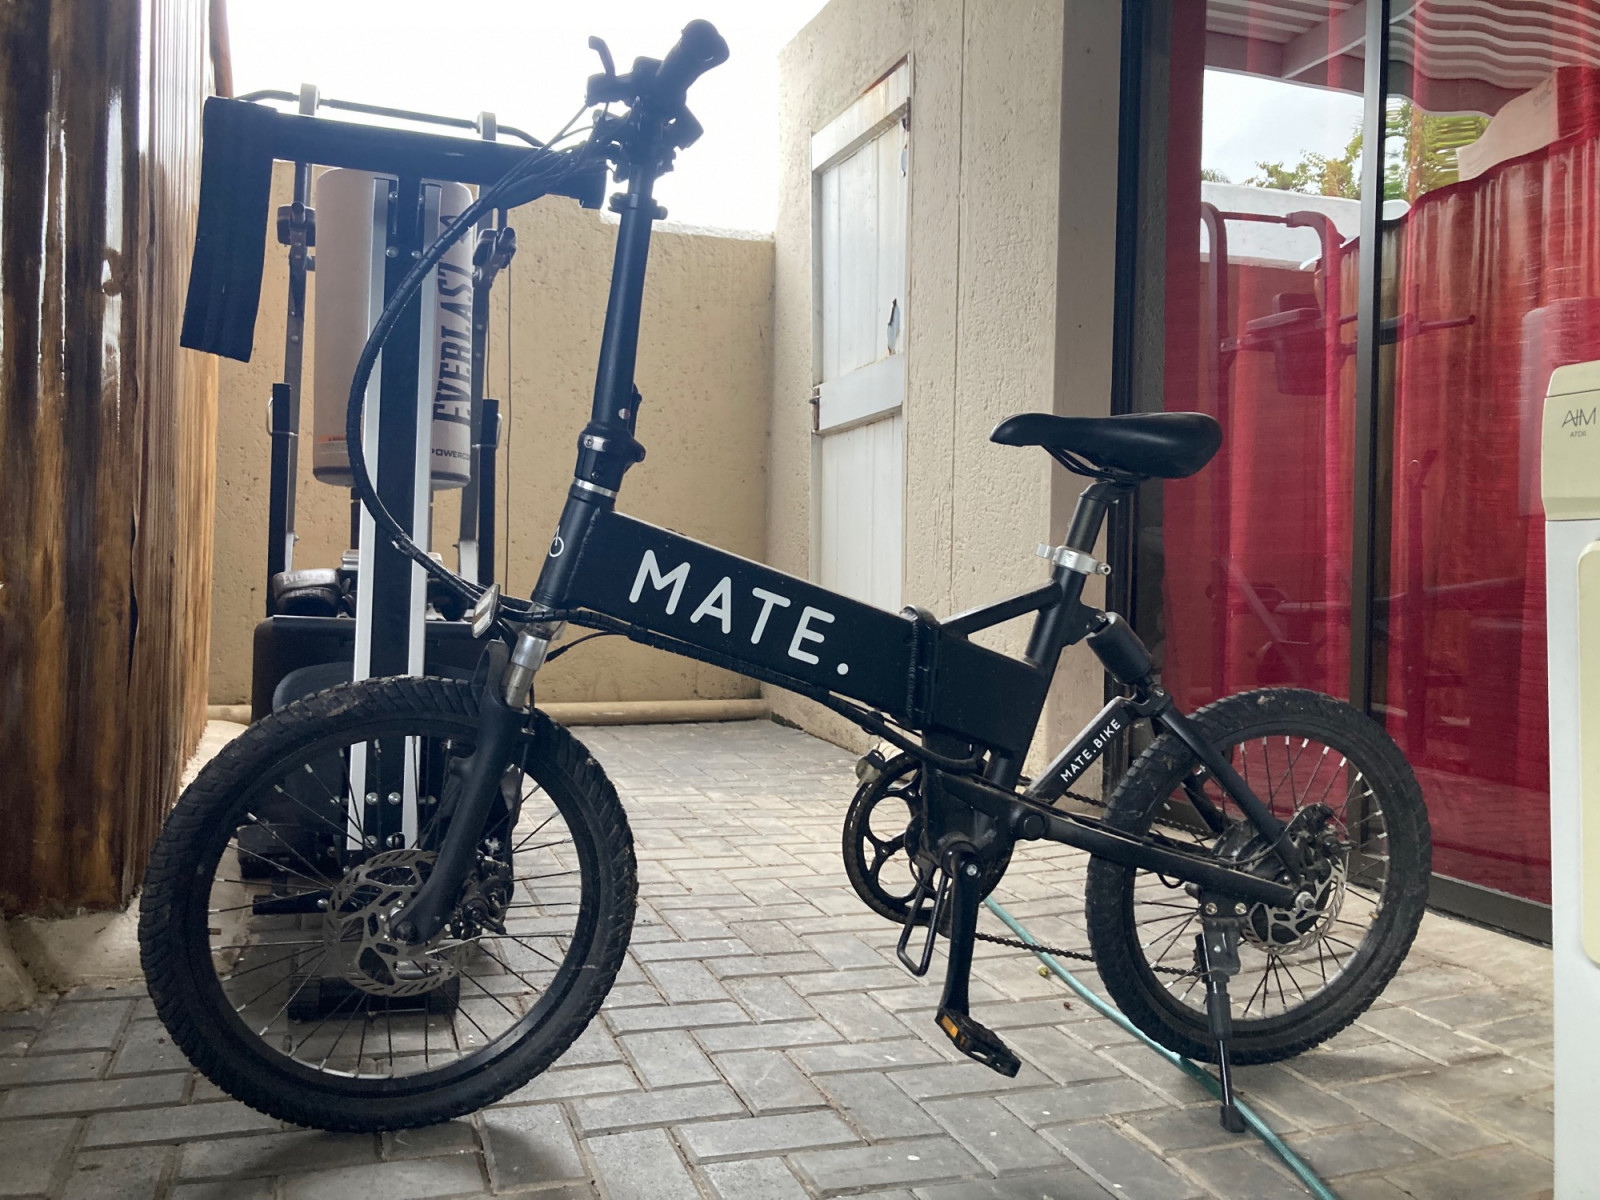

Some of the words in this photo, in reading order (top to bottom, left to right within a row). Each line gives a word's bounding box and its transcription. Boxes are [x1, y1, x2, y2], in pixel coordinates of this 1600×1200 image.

[1561, 406, 1597, 428] AIM
[629, 549, 849, 675] MATE.
[1060, 718, 1121, 782] MATE.BIKE
